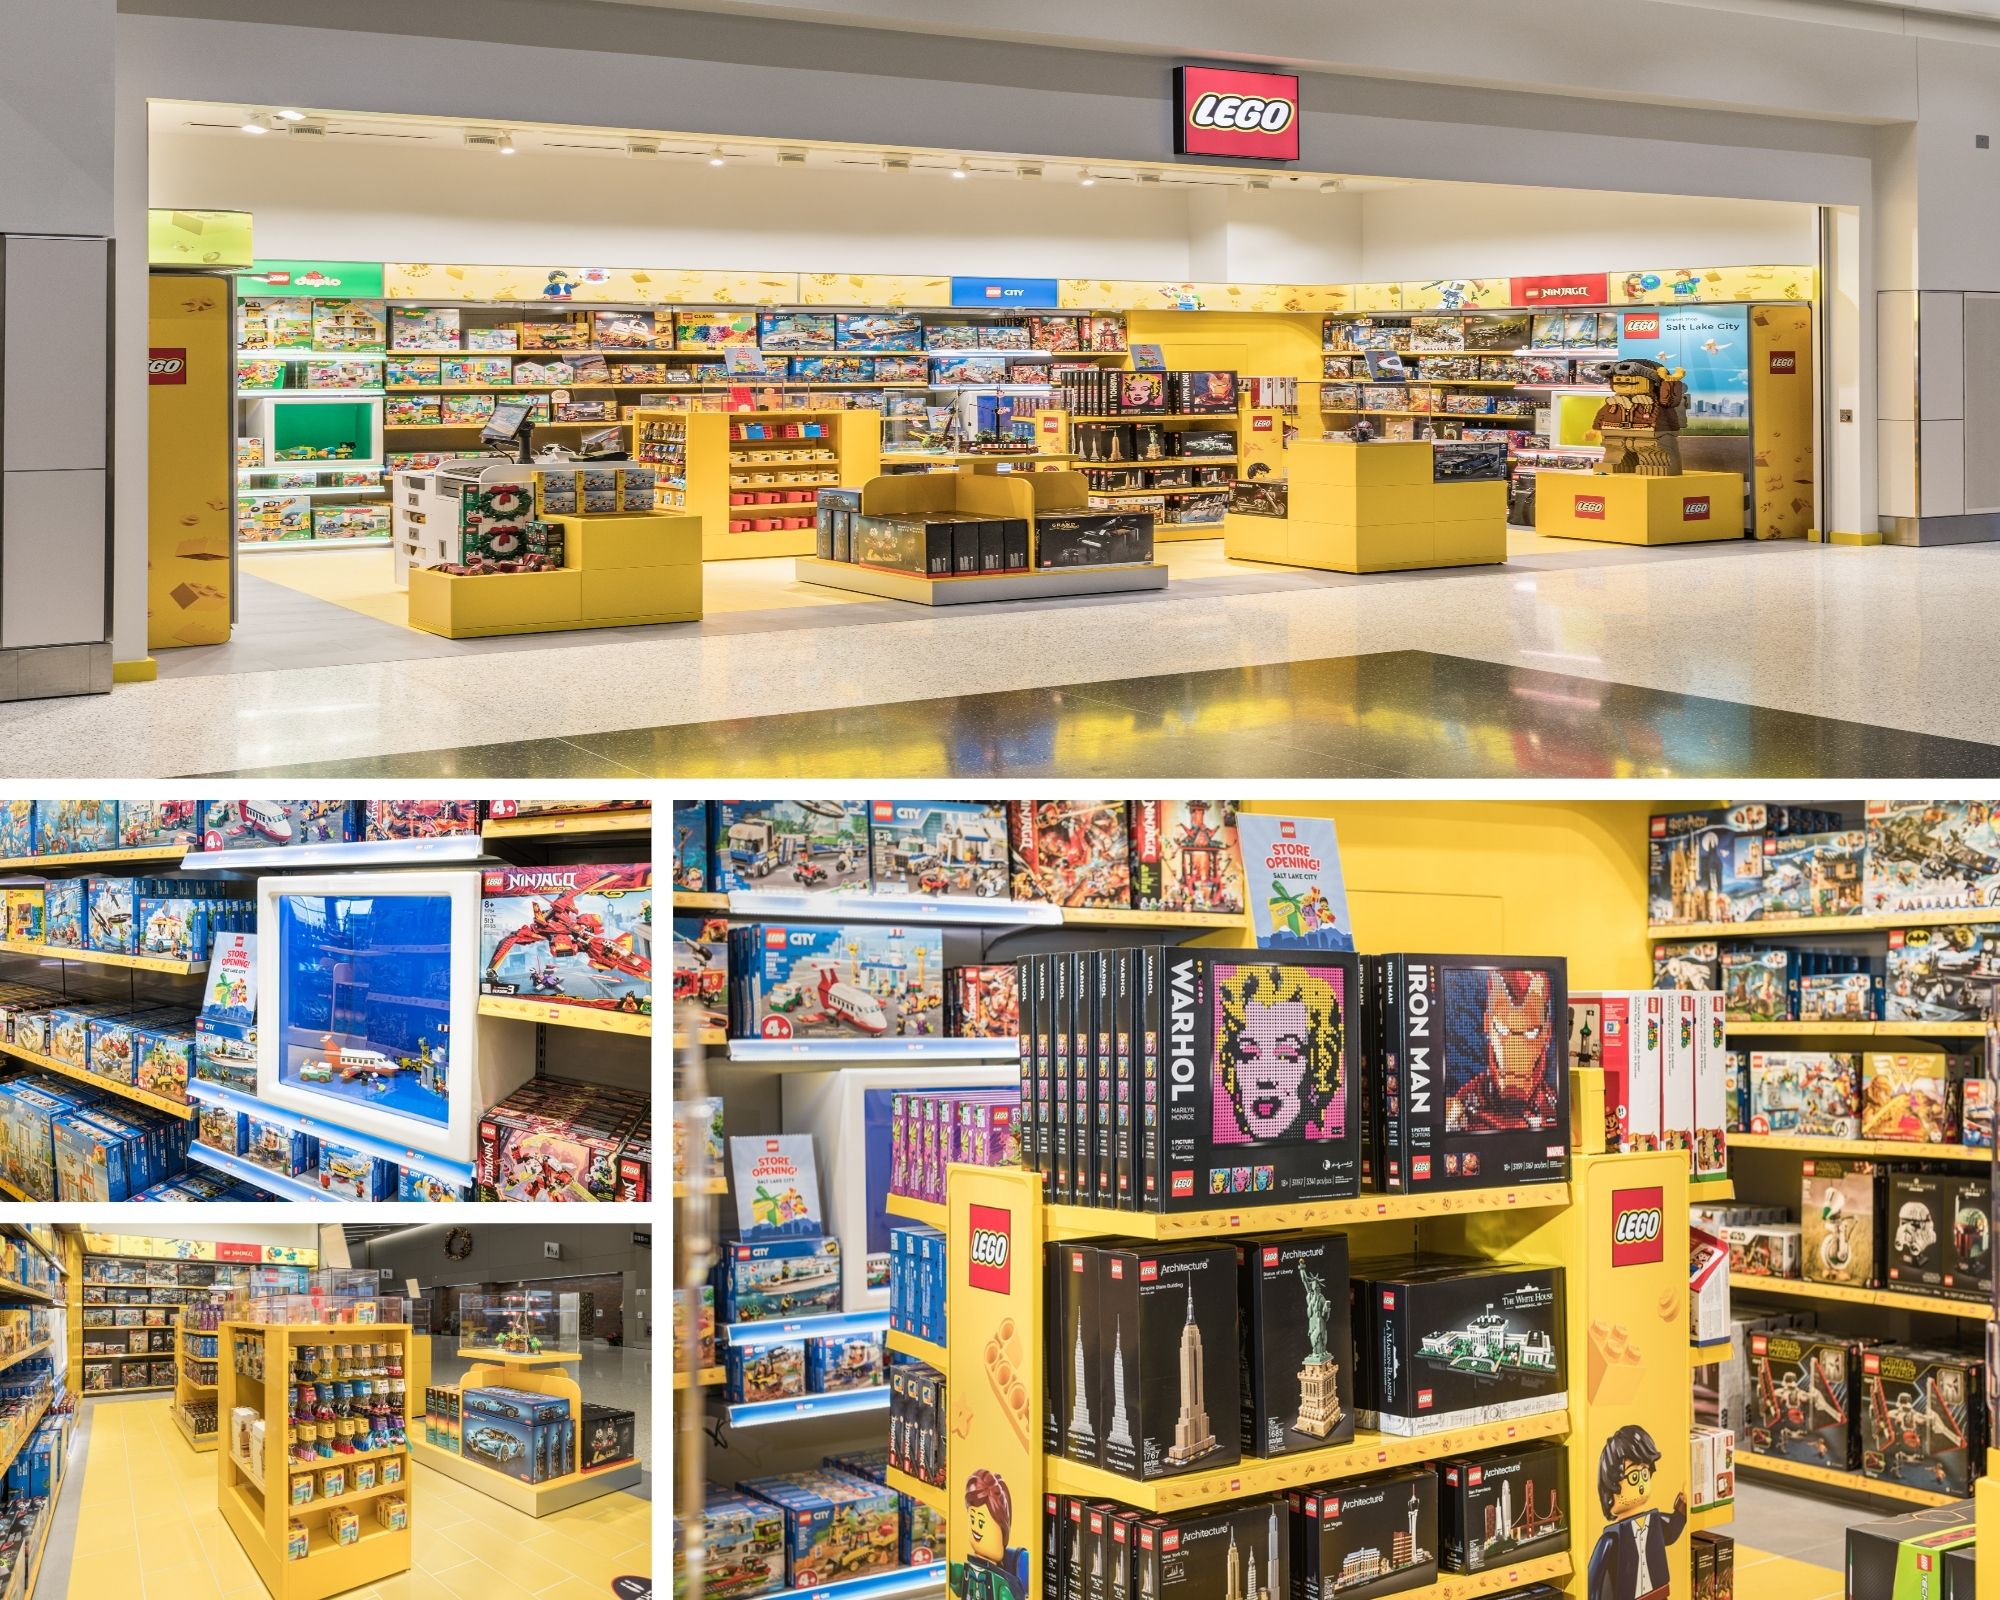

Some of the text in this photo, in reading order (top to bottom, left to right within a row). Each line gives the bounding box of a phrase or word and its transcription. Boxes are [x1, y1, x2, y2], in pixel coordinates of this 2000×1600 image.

[1190, 92, 1294, 134] LEGO
[1004, 289, 1024, 297] CITY
[1541, 286, 1590, 298] NINJAGO
[1625, 319, 1659, 333] LEGO
[1666, 322, 1740, 332] Salt Lake City
[149, 358, 184, 374] GO
[1770, 357, 1794, 369] LEGO
[1109, 373, 1118, 398] WARHOL
[1253, 419, 1272, 428] LEGO
[1577, 503, 1603, 513] LEGO
[1685, 504, 1708, 514] LEGO
[896, 807, 922, 820] CITY
[207, 837, 221, 849] 4+
[1272, 843, 1311, 857] STORE
[1265, 857, 1320, 872] OPENING!
[506, 872, 579, 891] NINJAGO
[789, 932, 817, 946] CITY
[227, 950, 248, 960] STORE
[221, 958, 251, 969] OPENING!
[204, 1023, 215, 1031] CITY
[766, 1019, 790, 1036] 4+
[1171, 959, 1195, 1102] WARHOL
[1408, 964, 1431, 1114] IRON MAN
[482, 1126, 496, 1135] LEGO
[481, 1139, 495, 1185] NINJAGO
[758, 1156, 790, 1167] STORE
[622, 1166, 640, 1176] LEGO
[752, 1166, 798, 1177] OPENING!
[1173, 1178, 1193, 1189] LEGO
[1615, 1208, 1661, 1244] LEGO
[752, 1247, 769, 1257] CITY
[971, 1229, 1009, 1266] LEGO
[1281, 1248, 1324, 1261] Architecture
[1160, 1261, 1208, 1277] Architecture
[1502, 1296, 1515, 1306] THE
[1515, 1294, 1534, 1304] WHITE
[1535, 1292, 1553, 1302] HOUSE
[1385, 1319, 1392, 1331] LA
[1144, 1451, 1160, 1461] 1767
[1483, 1464, 1521, 1481] Architecture
[1341, 1494, 1384, 1512] Architecture
[813, 1510, 830, 1521] CITY
[1182, 1525, 1228, 1544] Architecture
